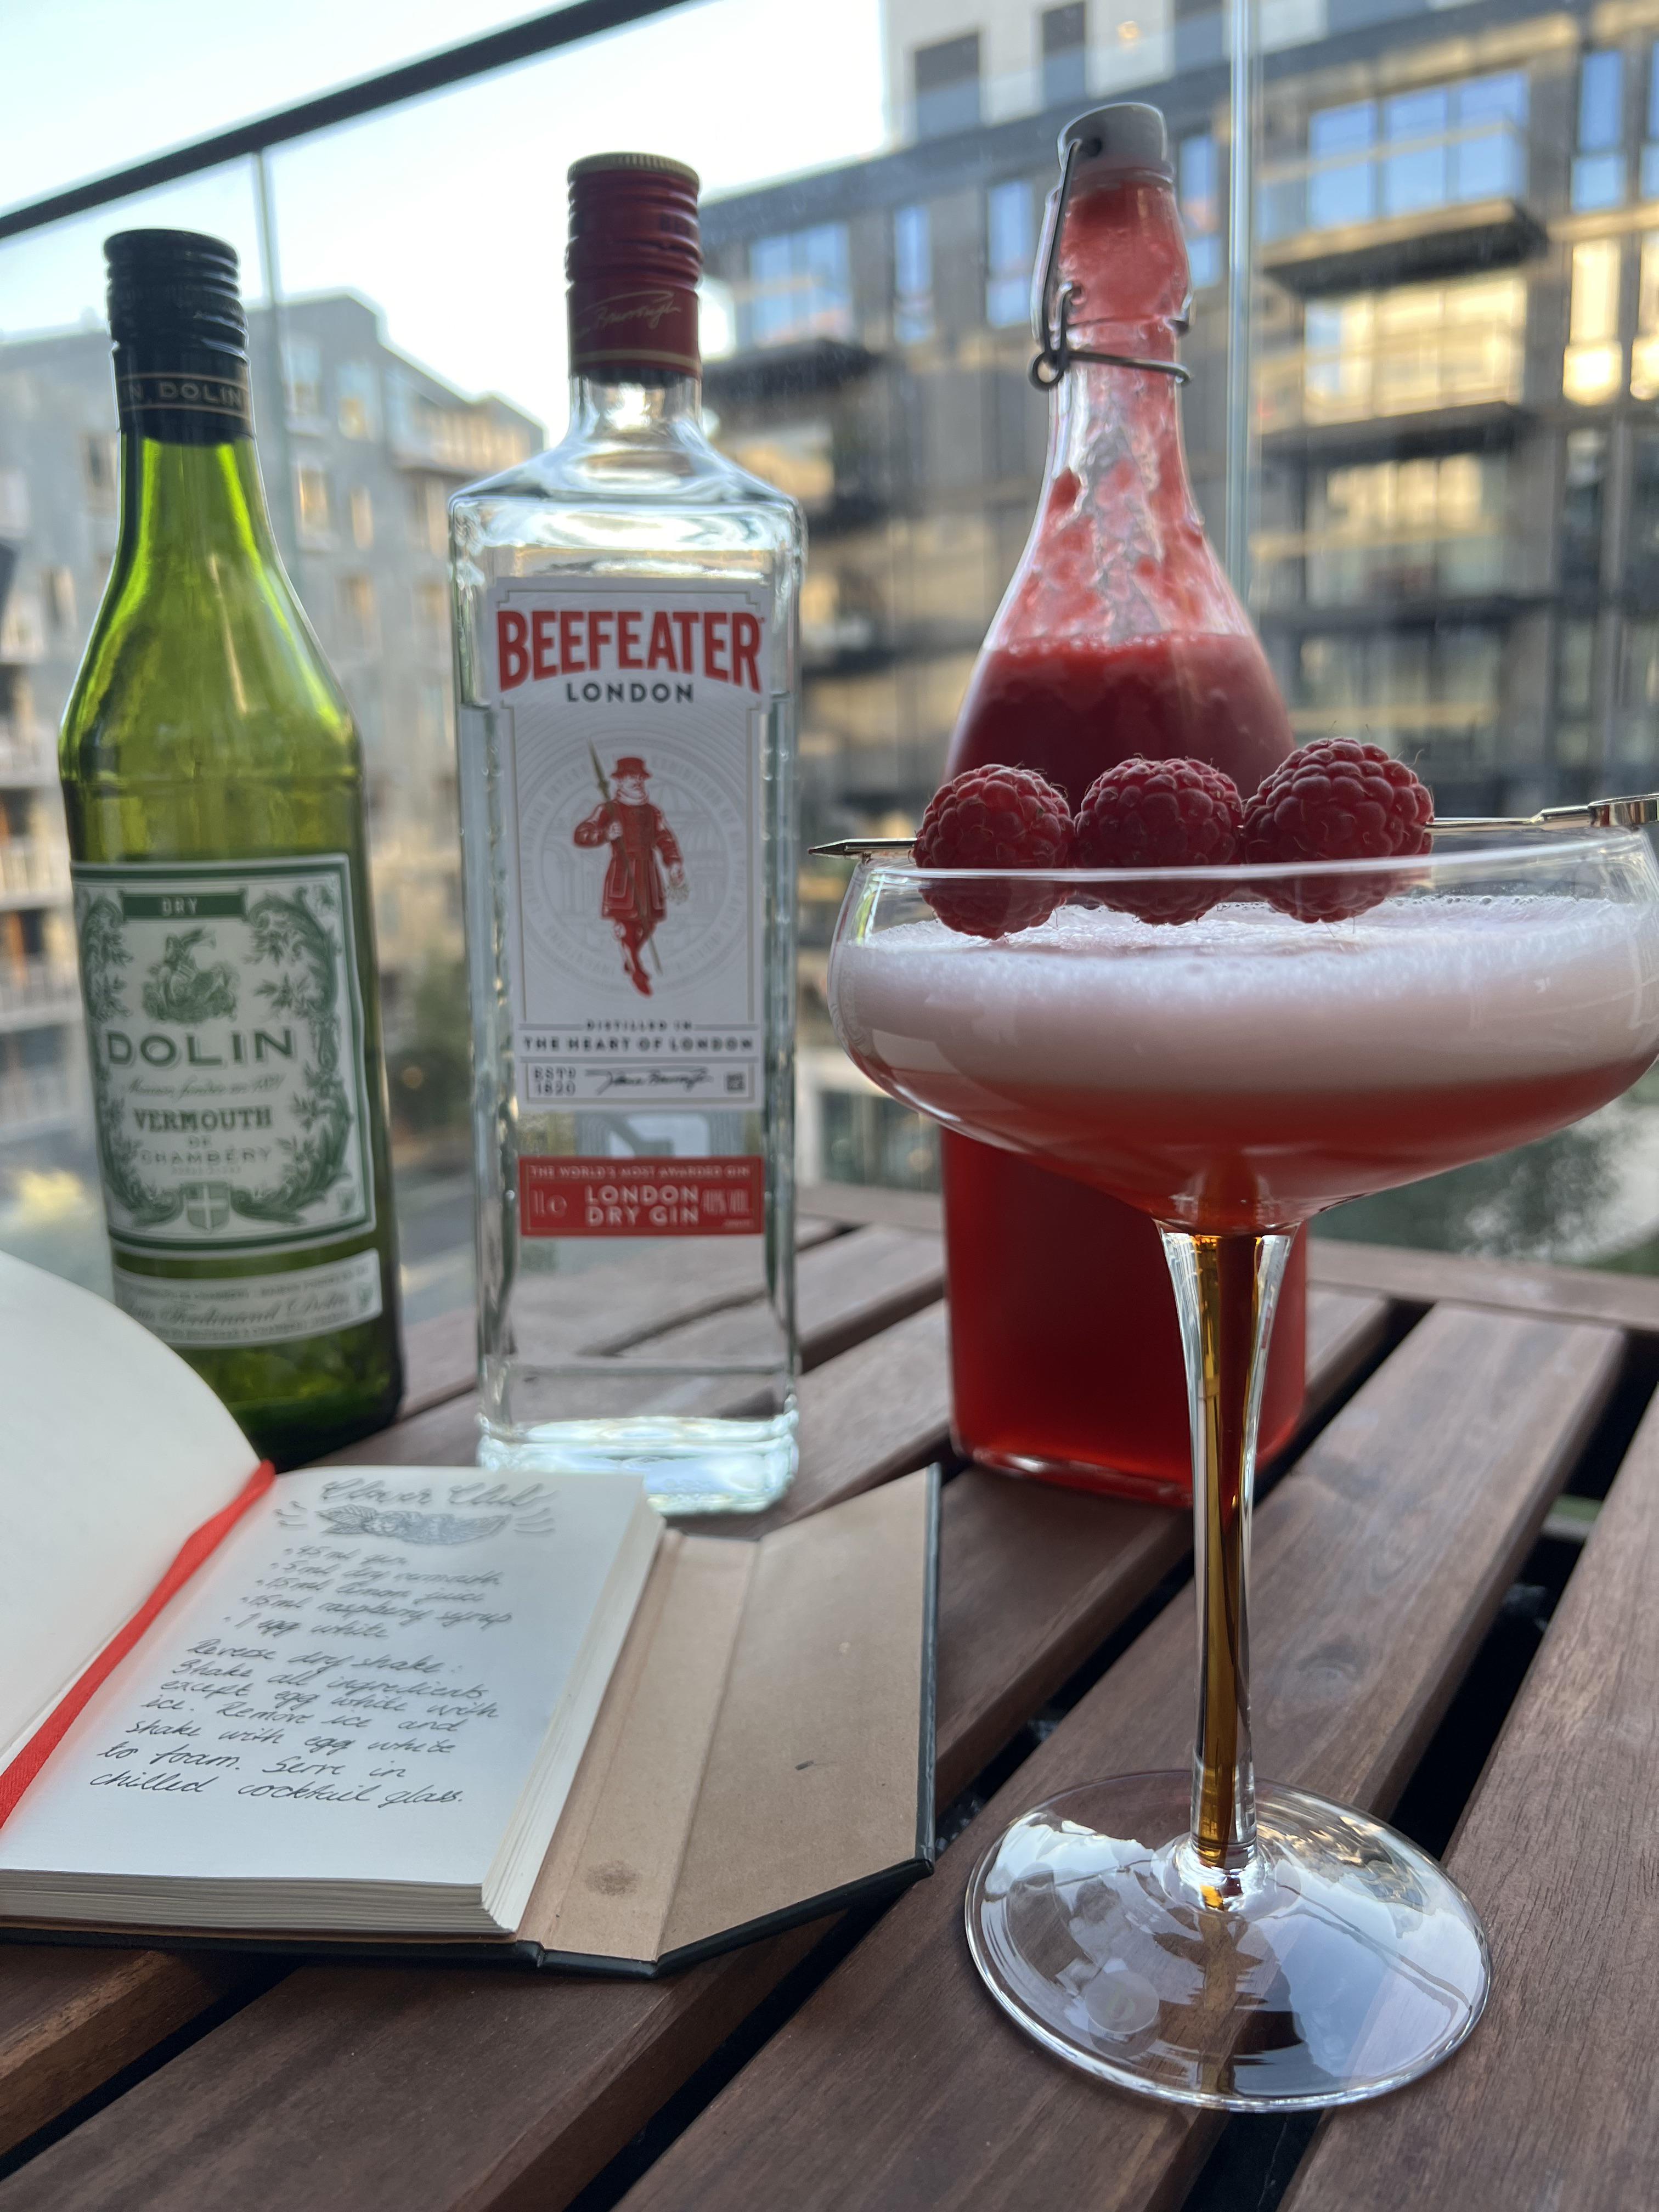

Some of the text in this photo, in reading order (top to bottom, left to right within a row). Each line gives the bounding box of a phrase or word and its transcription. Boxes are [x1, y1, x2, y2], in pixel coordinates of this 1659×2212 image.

[159, 381, 242, 410] DOLIN
[496, 610, 761, 693] BEEFEATER
[566, 681, 694, 704] LONDON
[161, 897, 199, 916] DRY
[585, 1019, 693, 1031] DISTILLED IN
[106, 1029, 297, 1067] DOLIN
[523, 1036, 754, 1052] THE HEART OF LONDON
[535, 1081, 577, 1096] 1820
[132, 1104, 273, 1133] VERMOUTH
[529, 1165, 555, 1179] THE
[620, 1165, 655, 1179] MOST
[724, 1165, 751, 1179] GIN
[584, 1184, 699, 1206] LONDON
[584, 1206, 640, 1227] DRY
[648, 1206, 699, 1227] GIN
[320, 1477, 557, 1507] Clover Club
[358, 1551, 409, 1566] gin
[341, 1566, 391, 1582] dry
[393, 1570, 505, 1587] vermouth
[336, 1579, 411, 1598] lemon
[411, 1587, 487, 1605] juice
[257, 1619, 302, 1638] egg
[309, 1620, 388, 1638] white
[435, 1611, 514, 1631] syrup
[185, 1638, 278, 1662] Reverse
[287, 1651, 355, 1675] dry
[171, 1658, 489, 1701] Shake all ingredients
[160, 1679, 499, 1719] except egg white with
[215, 1701, 315, 1724] Remove
[320, 1710, 373, 1729] ice
[396, 1718, 468, 1733] and
[125, 1719, 456, 1756] shake with egg white
[97, 1741, 137, 1761] to
[262, 1755, 346, 1776] Serve
[368, 1760, 407, 1778] in
[90, 1769, 216, 1793] chilled
[238, 1781, 381, 1803] cocktail
